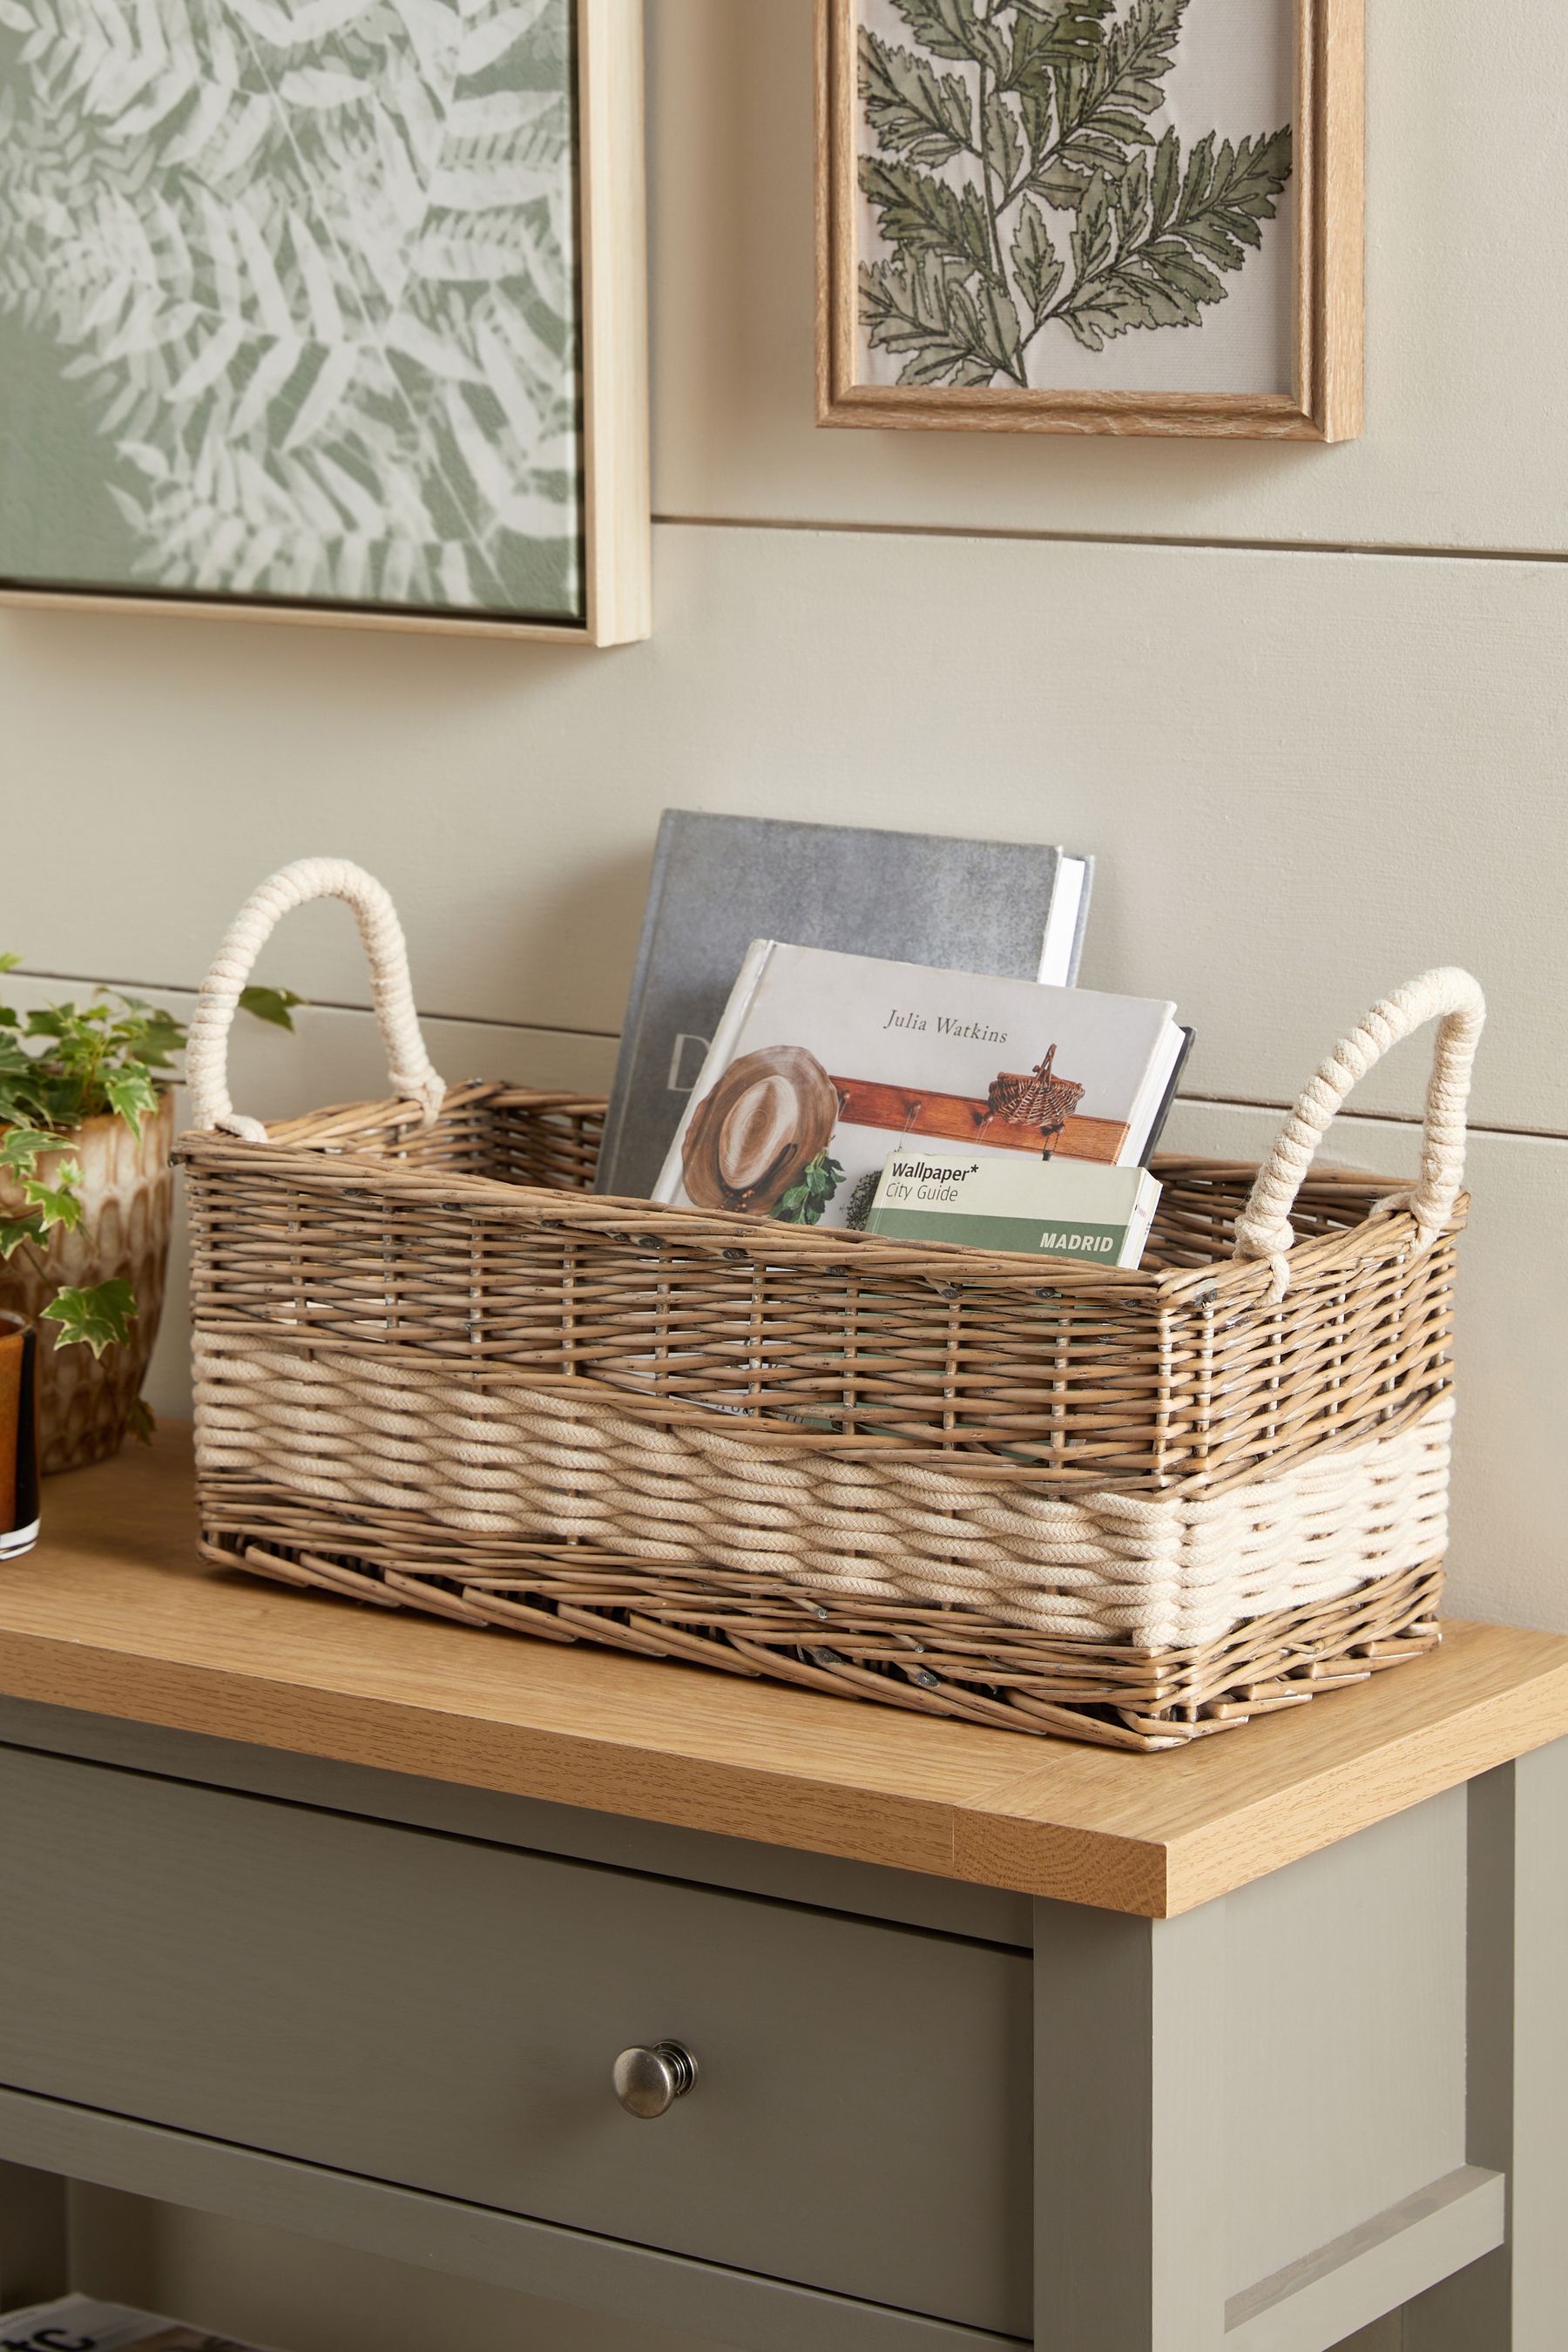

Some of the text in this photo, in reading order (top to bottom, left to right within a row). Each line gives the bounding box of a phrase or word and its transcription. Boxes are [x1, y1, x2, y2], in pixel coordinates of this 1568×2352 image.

[883, 1010, 1008, 1044] Julia Watkins
[886, 1182, 958, 1201] City Guide
[1040, 1233, 1113, 1253] MADRID
